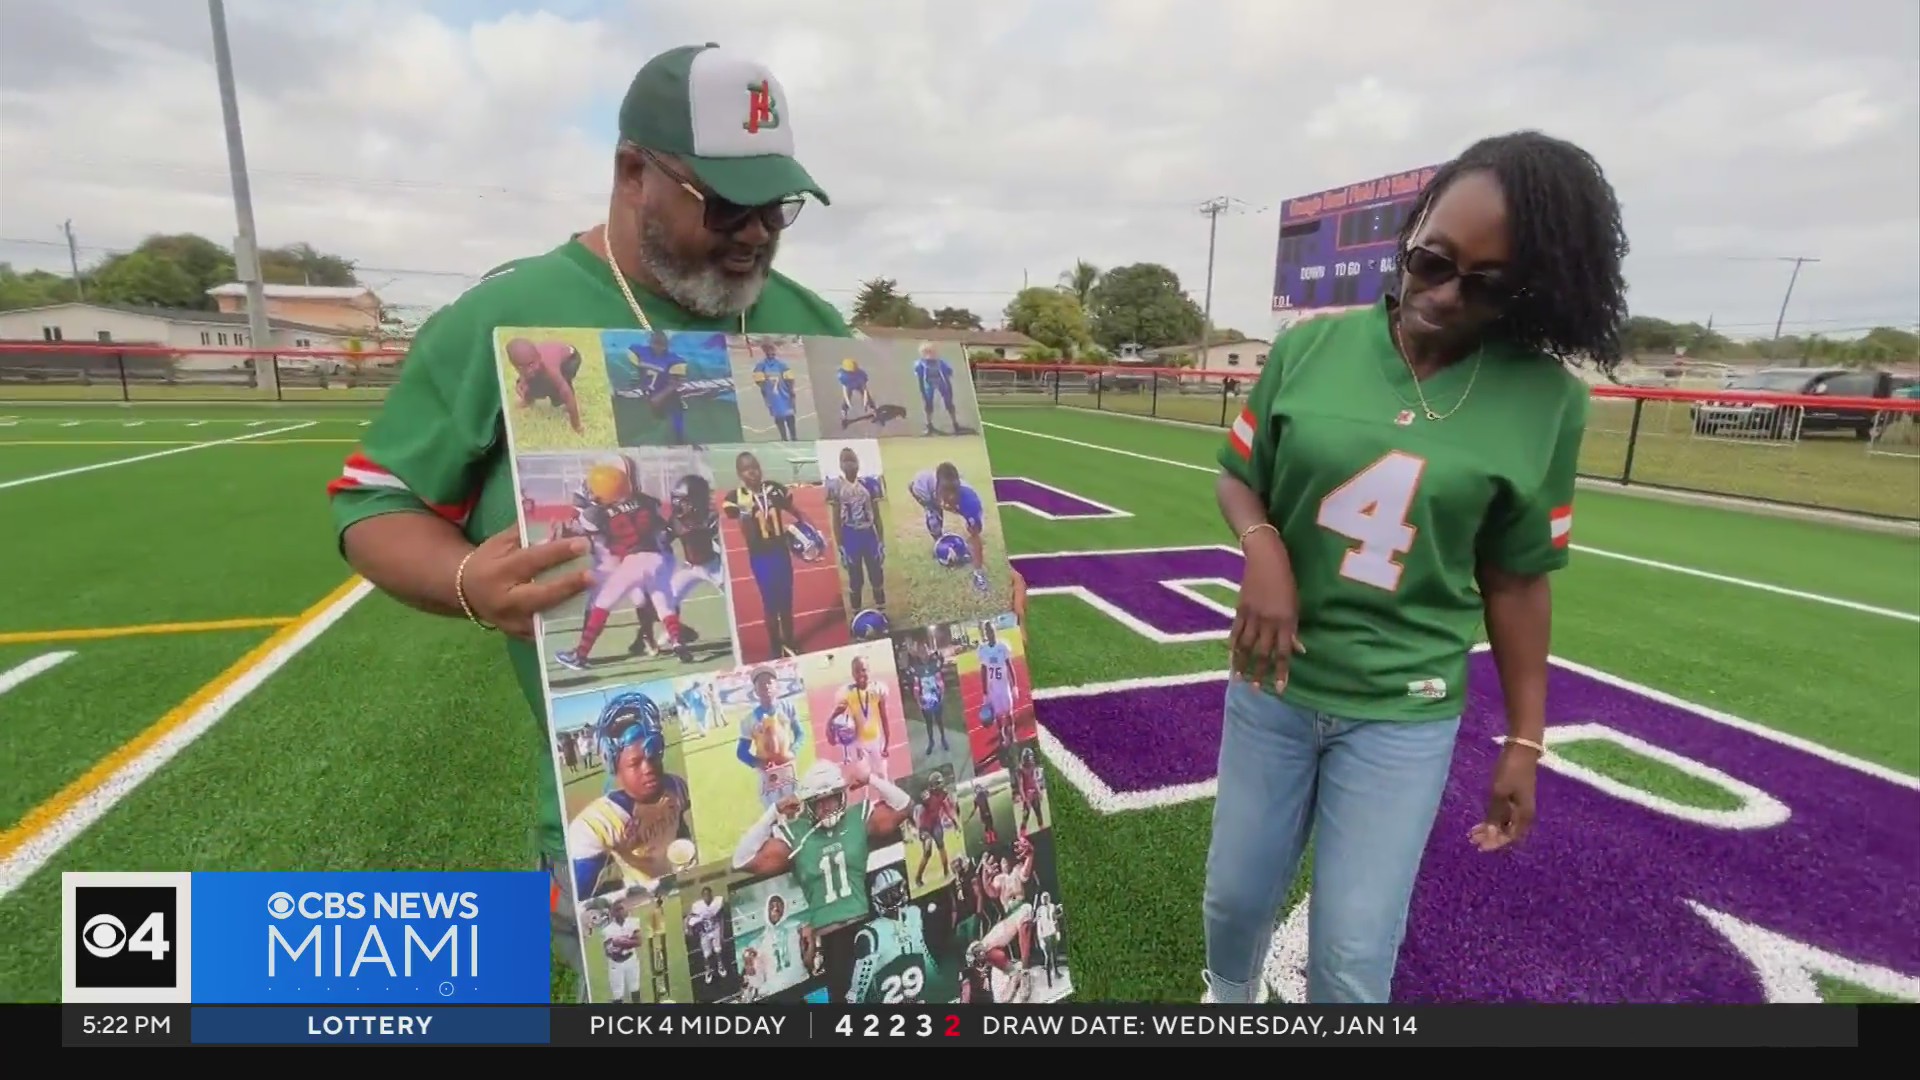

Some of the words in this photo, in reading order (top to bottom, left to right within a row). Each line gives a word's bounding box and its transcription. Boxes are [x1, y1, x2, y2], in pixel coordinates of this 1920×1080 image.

[1300, 265, 1326, 280] DOWN
[1335, 262, 1346, 276] TO
[1347, 261, 1361, 276] GO
[646, 369, 659, 391] 7
[1316, 449, 1426, 592] 4
[988, 666, 1002, 680] 76
[818, 850, 853, 904] 11
[880, 965, 925, 1004] 29
